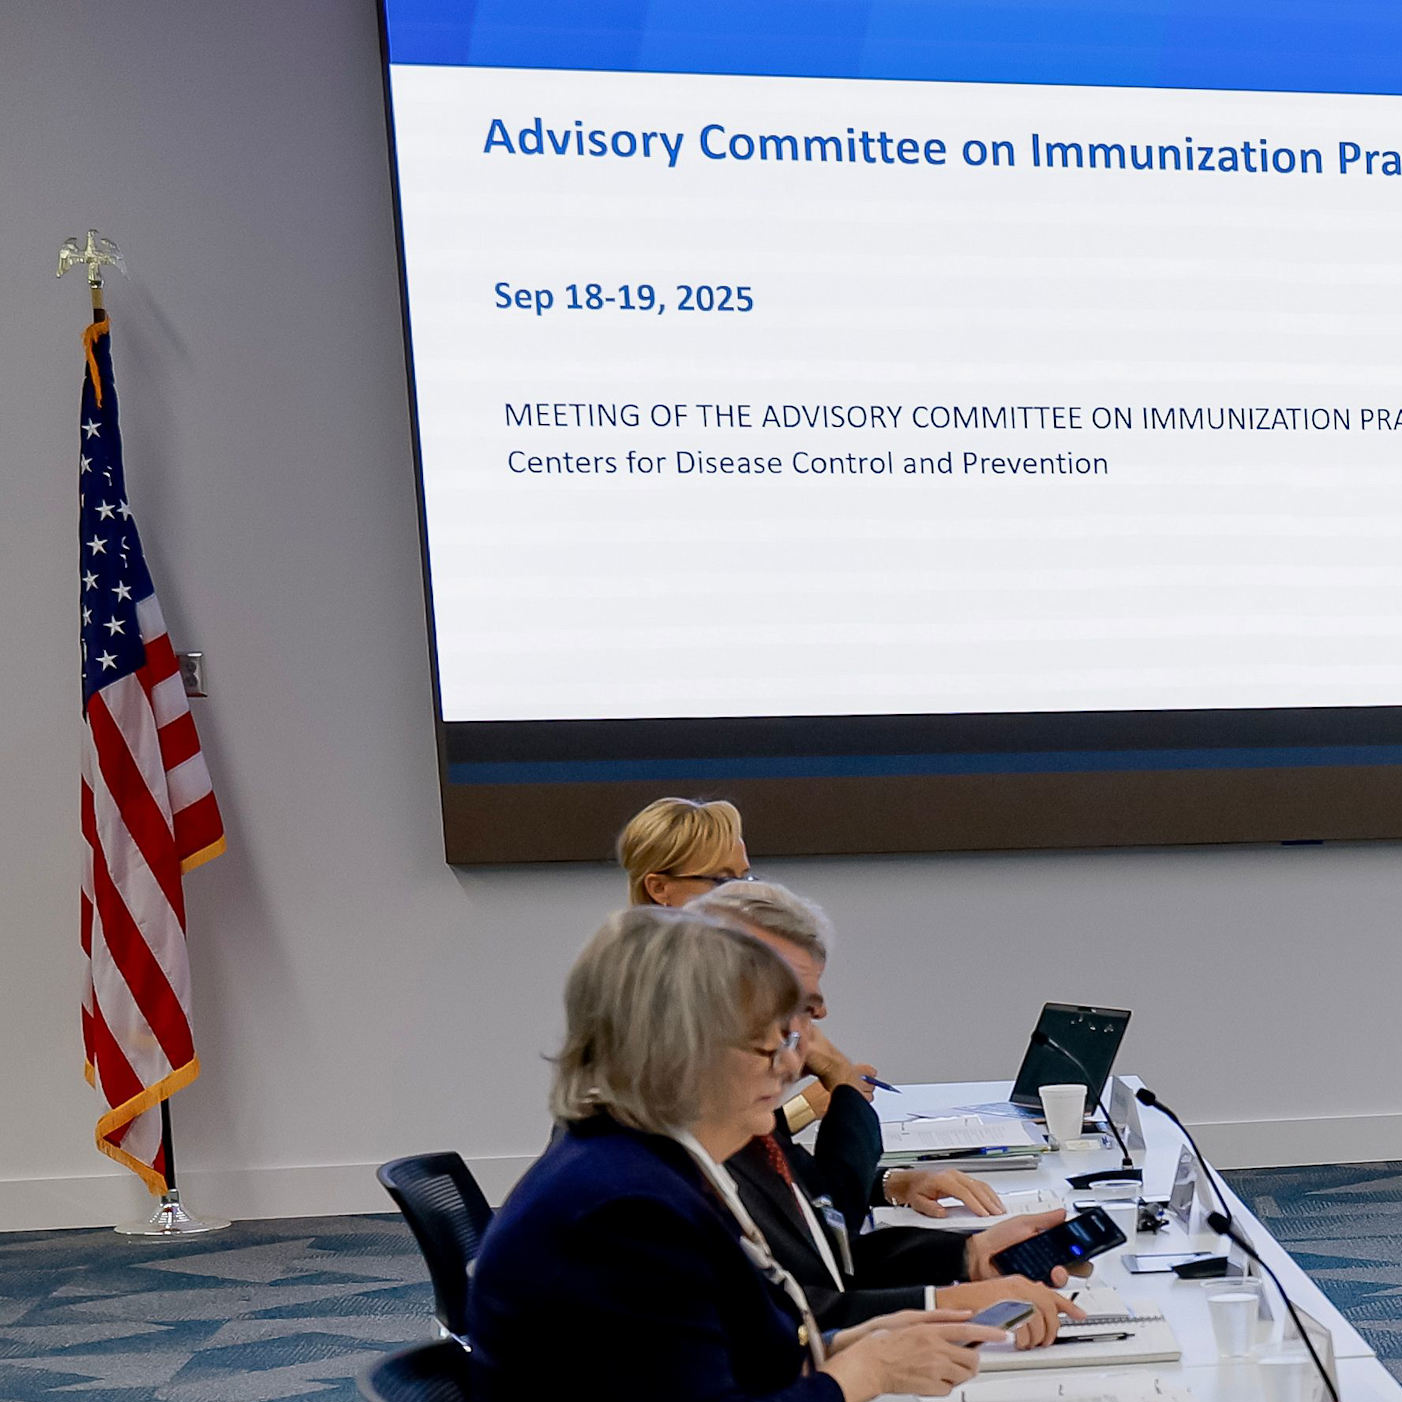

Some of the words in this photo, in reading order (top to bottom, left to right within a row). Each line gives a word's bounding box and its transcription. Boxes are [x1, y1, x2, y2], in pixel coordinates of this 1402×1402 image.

[484, 117, 684, 167] Advisory
[700, 124, 946, 165] Committee
[963, 140, 1014, 167] on
[1032, 134, 1322, 174] Immunization
[494, 282, 554, 317] Sep
[565, 283, 665, 316] 18-19,
[676, 284, 754, 313] 2025
[505, 403, 640, 427] MEETING
[650, 404, 688, 428] OF
[696, 404, 753, 428] THE
[762, 405, 903, 429] ADVISORY
[912, 405, 1083, 430] COMMITTEE
[1092, 407, 1132, 430] ON
[1142, 408, 1350, 431] IMMUNIZATION
[508, 450, 618, 474] Centers
[625, 450, 667, 474] for
[676, 450, 783, 474] Disease
[792, 450, 893, 475] Control
[903, 451, 953, 475] and
[963, 451, 1108, 475] Prevention
